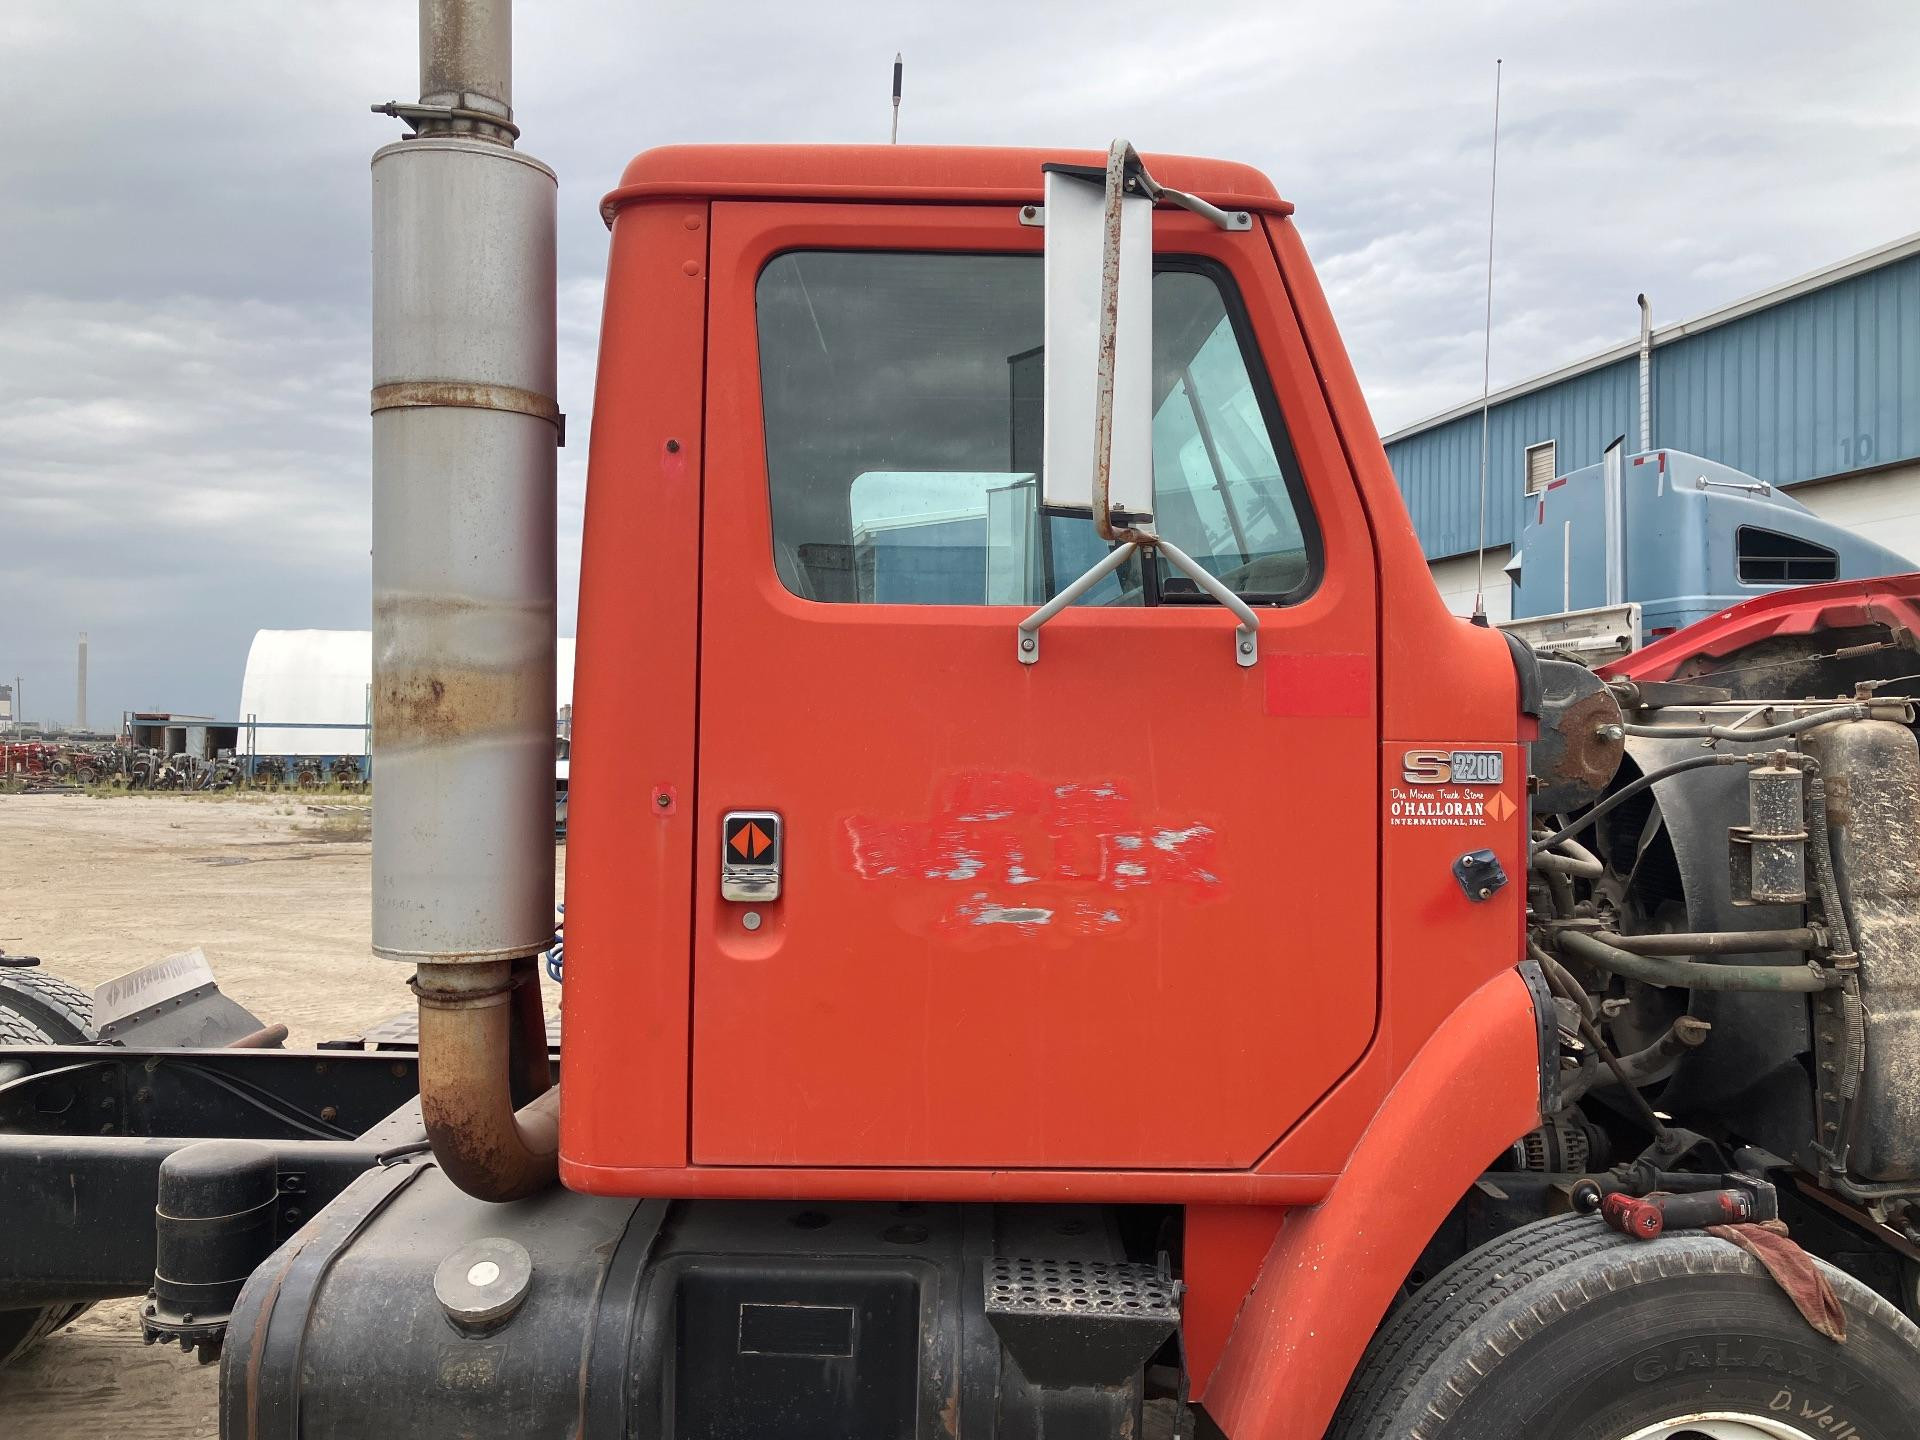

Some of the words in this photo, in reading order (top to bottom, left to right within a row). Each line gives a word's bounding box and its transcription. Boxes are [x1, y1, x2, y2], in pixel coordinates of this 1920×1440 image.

[1840, 434, 1873, 465] 10
[1403, 750, 1452, 784] S
[1454, 754, 1499, 780] 2200
[1390, 788, 1406, 800] Des
[1409, 788, 1435, 800] Moines
[1436, 788, 1460, 800] Truck
[1463, 788, 1485, 800] Store
[1391, 801, 1484, 816] O'HALLORAN
[1391, 818, 1468, 826] INTERNATIONAL,
[1469, 818, 1486, 826] INC.
[1633, 1343, 1865, 1395] GALAXY
